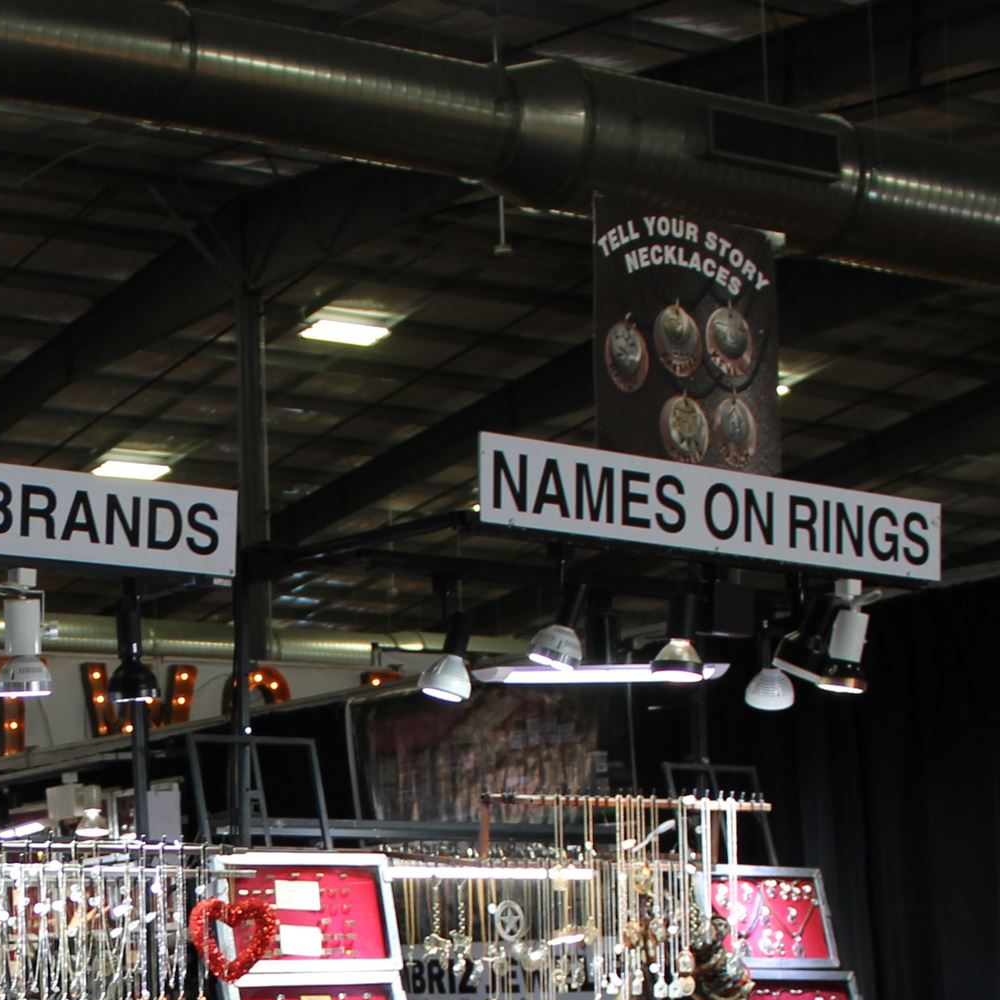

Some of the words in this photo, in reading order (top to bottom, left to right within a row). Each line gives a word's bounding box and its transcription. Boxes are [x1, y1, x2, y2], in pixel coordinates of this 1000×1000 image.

[597, 220, 640, 257] TELL
[644, 216, 699, 243] YOUR
[704, 231, 770, 291] STORY
[624, 245, 742, 296] NECKLACES
[492, 450, 687, 534] NAMES
[704, 482, 775, 545] ON
[788, 495, 929, 566] RINGS
[403, 958, 477, 994] BRIZ
